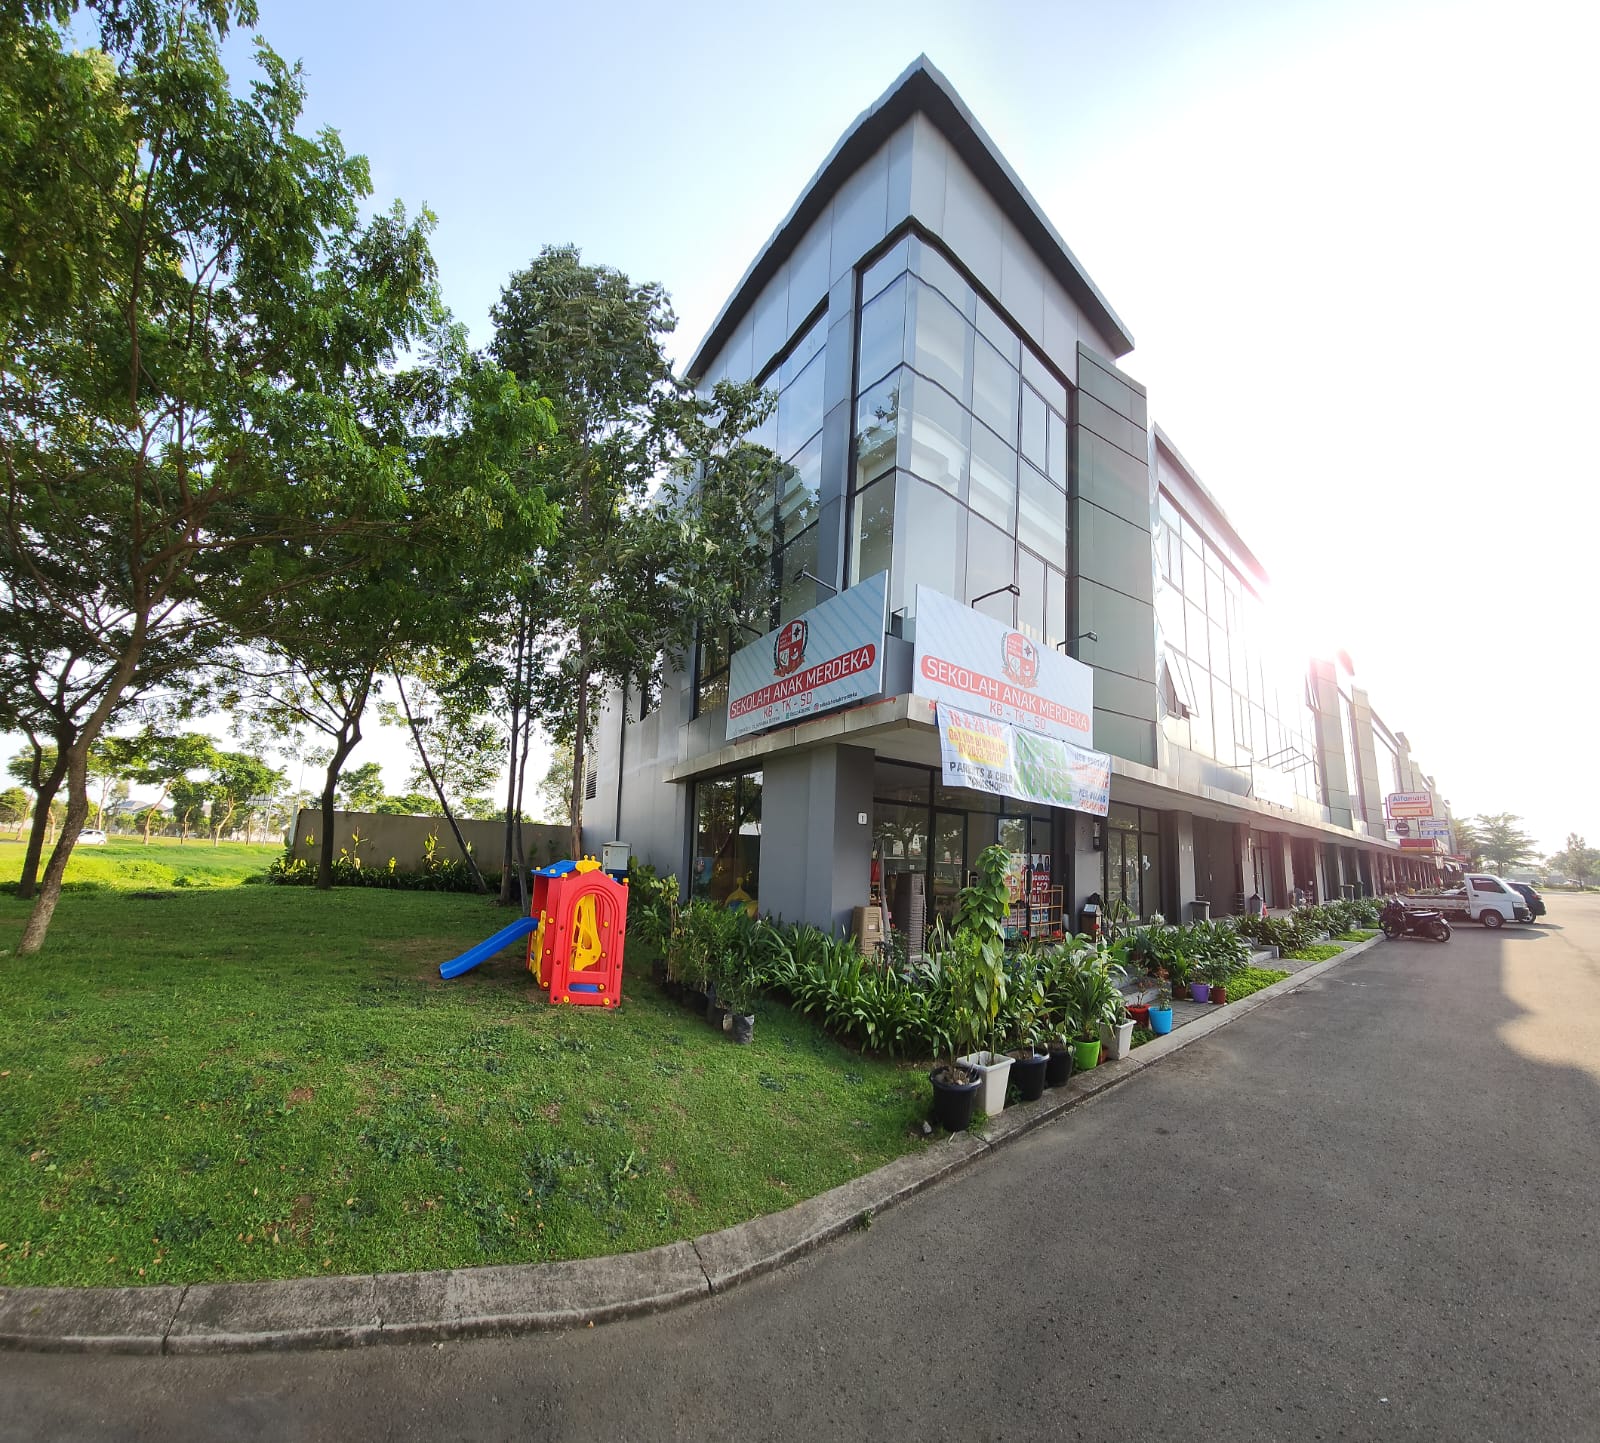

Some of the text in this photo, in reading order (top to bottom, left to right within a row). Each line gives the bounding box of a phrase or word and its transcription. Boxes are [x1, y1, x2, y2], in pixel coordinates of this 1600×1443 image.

[731, 648, 871, 717] SEKOLAH ANAK MERDEKA
[763, 706, 773, 719] KB
[782, 700, 791, 712] TK
[801, 691, 813, 707] SD
[926, 658, 1088, 730] SEKOLAH ANAK MERDEKA
[989, 701, 1001, 716] KB
[1014, 709, 1025, 724] TK
[1034, 717, 1047, 730] SD
